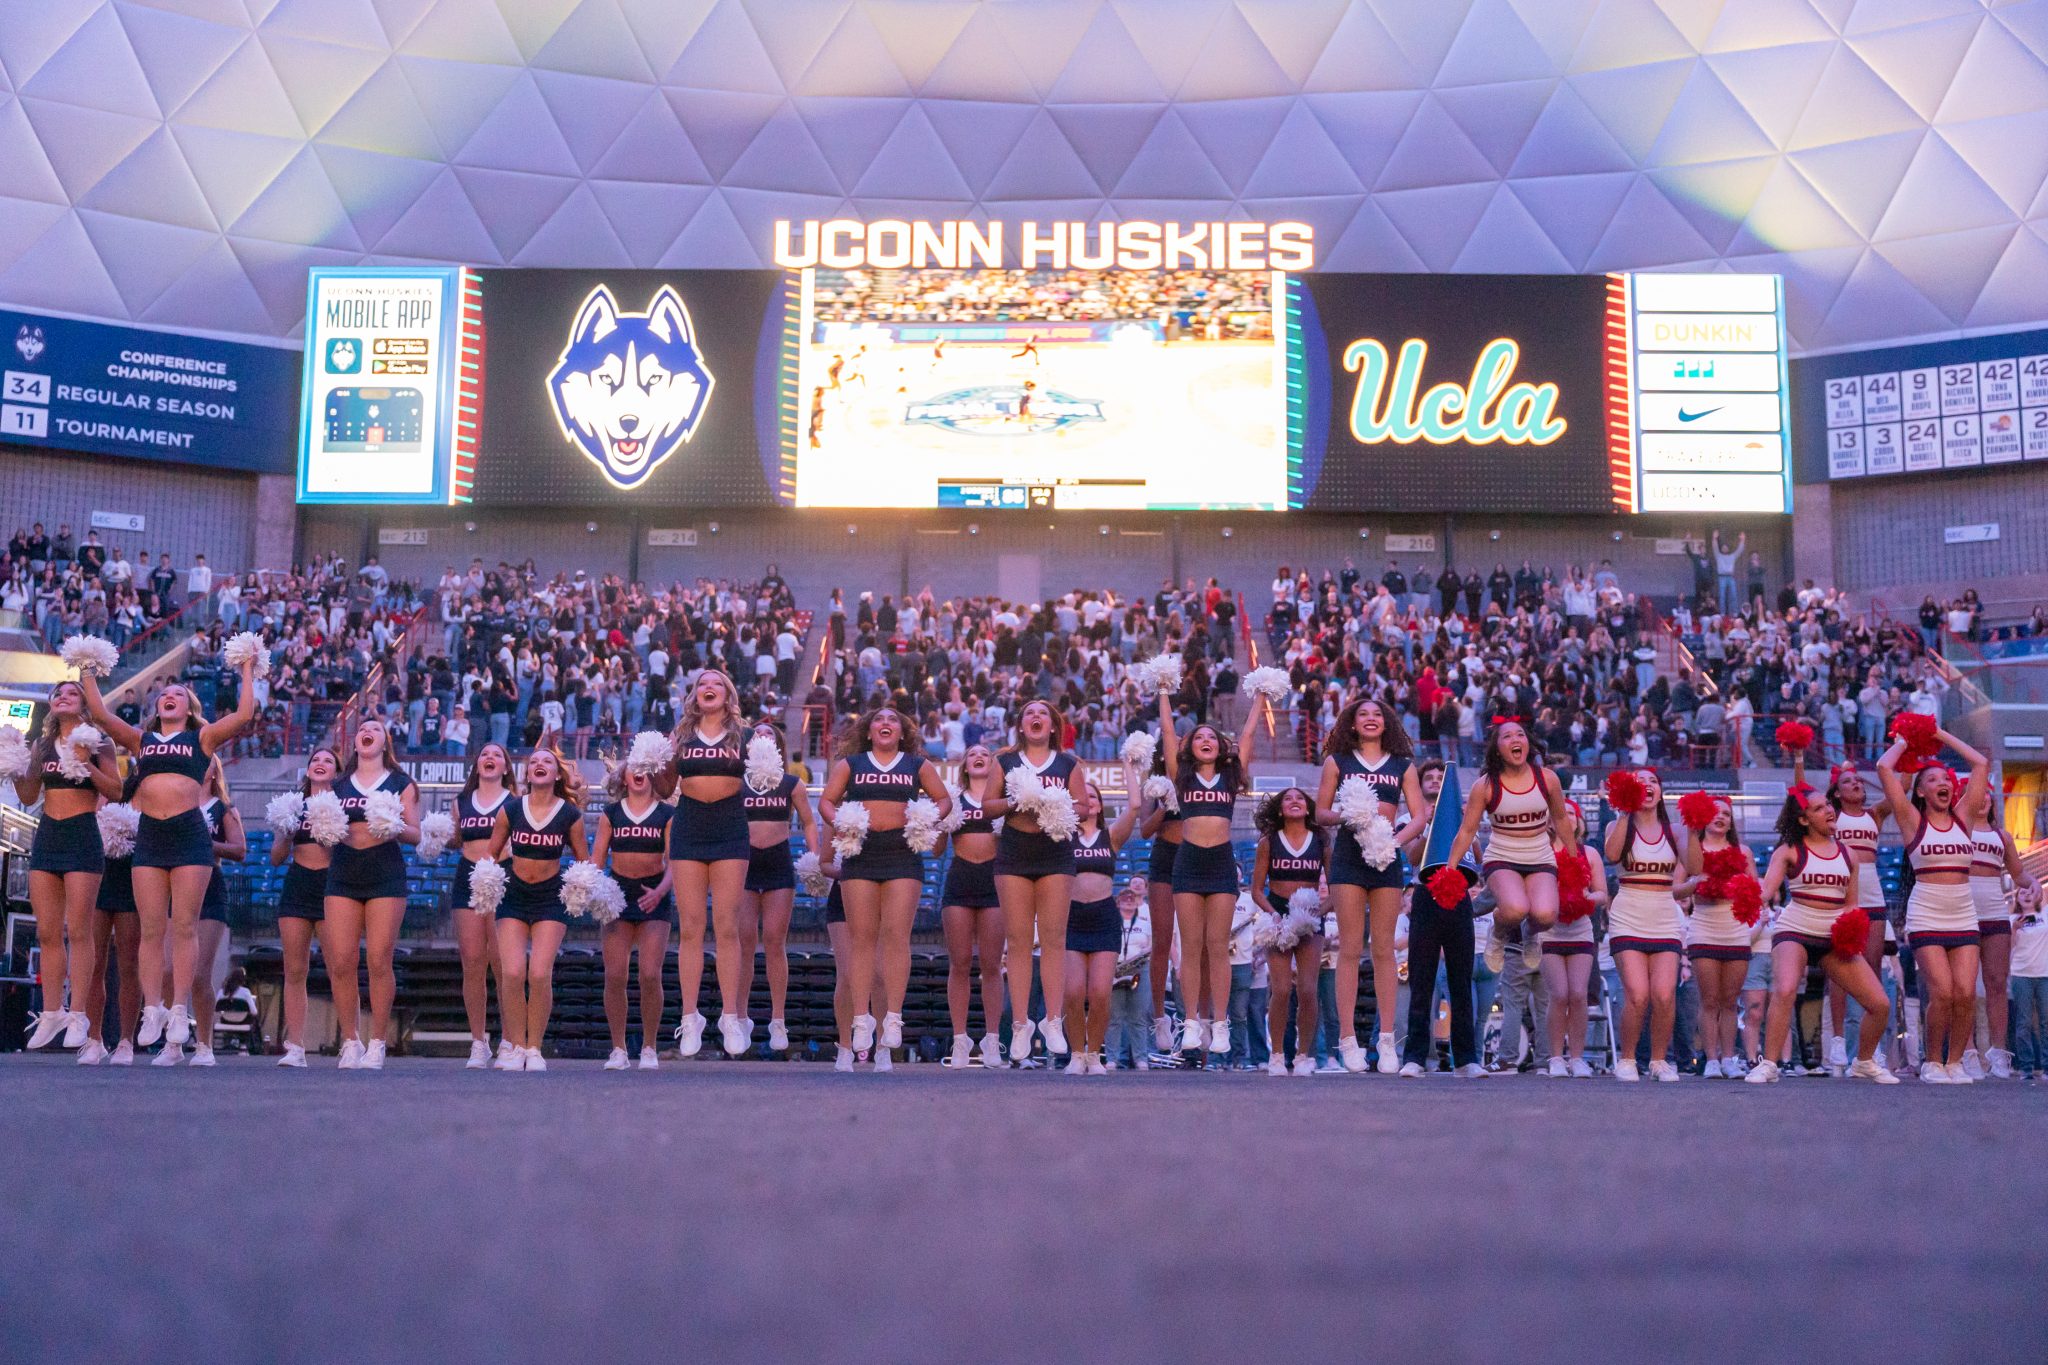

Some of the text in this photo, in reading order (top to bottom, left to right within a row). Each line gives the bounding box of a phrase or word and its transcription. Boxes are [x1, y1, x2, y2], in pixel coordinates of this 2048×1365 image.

[774, 219, 1314, 270] UCONN HUSKIES
[328, 288, 433, 296] UCONN HUSKIES
[326, 300, 431, 328] MOBILE APP
[120, 350, 227, 375] CONFERENCE
[107, 364, 237, 392] CHAMPIONSHIPS
[1945, 368, 1973, 386] 32
[1984, 363, 2013, 380] 42
[11, 377, 42, 397] 34
[1867, 377, 1896, 394] 44
[1913, 373, 1927, 390] 9
[1343, 337, 1568, 445] Ucla
[1829, 381, 1857, 399] 34
[56, 385, 235, 420] REGULAR SEASON
[16, 412, 35, 430] 11
[1954, 420, 1968, 436] C
[55, 418, 194, 448] TOURNAMENT
[1836, 431, 1856, 449] 13
[1877, 428, 1890, 444] 3
[1908, 423, 1937, 441] 24
[130, 517, 138, 528] 6
[403, 531, 426, 542] 213
[672, 533, 695, 543] 214
[1983, 526, 1992, 538] 7
[1408, 539, 1434, 550] 216
[140, 744, 193, 759] UCONN
[682, 747, 740, 759] UCONN
[420, 761, 467, 783] CAPITAL
[855, 773, 913, 786] UCONN
[340, 797, 368, 809] UCO
[744, 797, 787, 807] CONN
[1183, 790, 1231, 803] UCONN
[460, 817, 496, 829] UCON
[1494, 808, 1547, 824] UCONN
[512, 830, 563, 846] UCONN
[613, 827, 662, 838] UCONN
[1834, 829, 1878, 841] UCONN
[1073, 848, 1111, 858] CONN
[1920, 843, 1973, 856] UCONN
[1971, 842, 2004, 856] CONN
[1272, 858, 1321, 870] UCONN
[1626, 862, 1676, 873] UCONN
